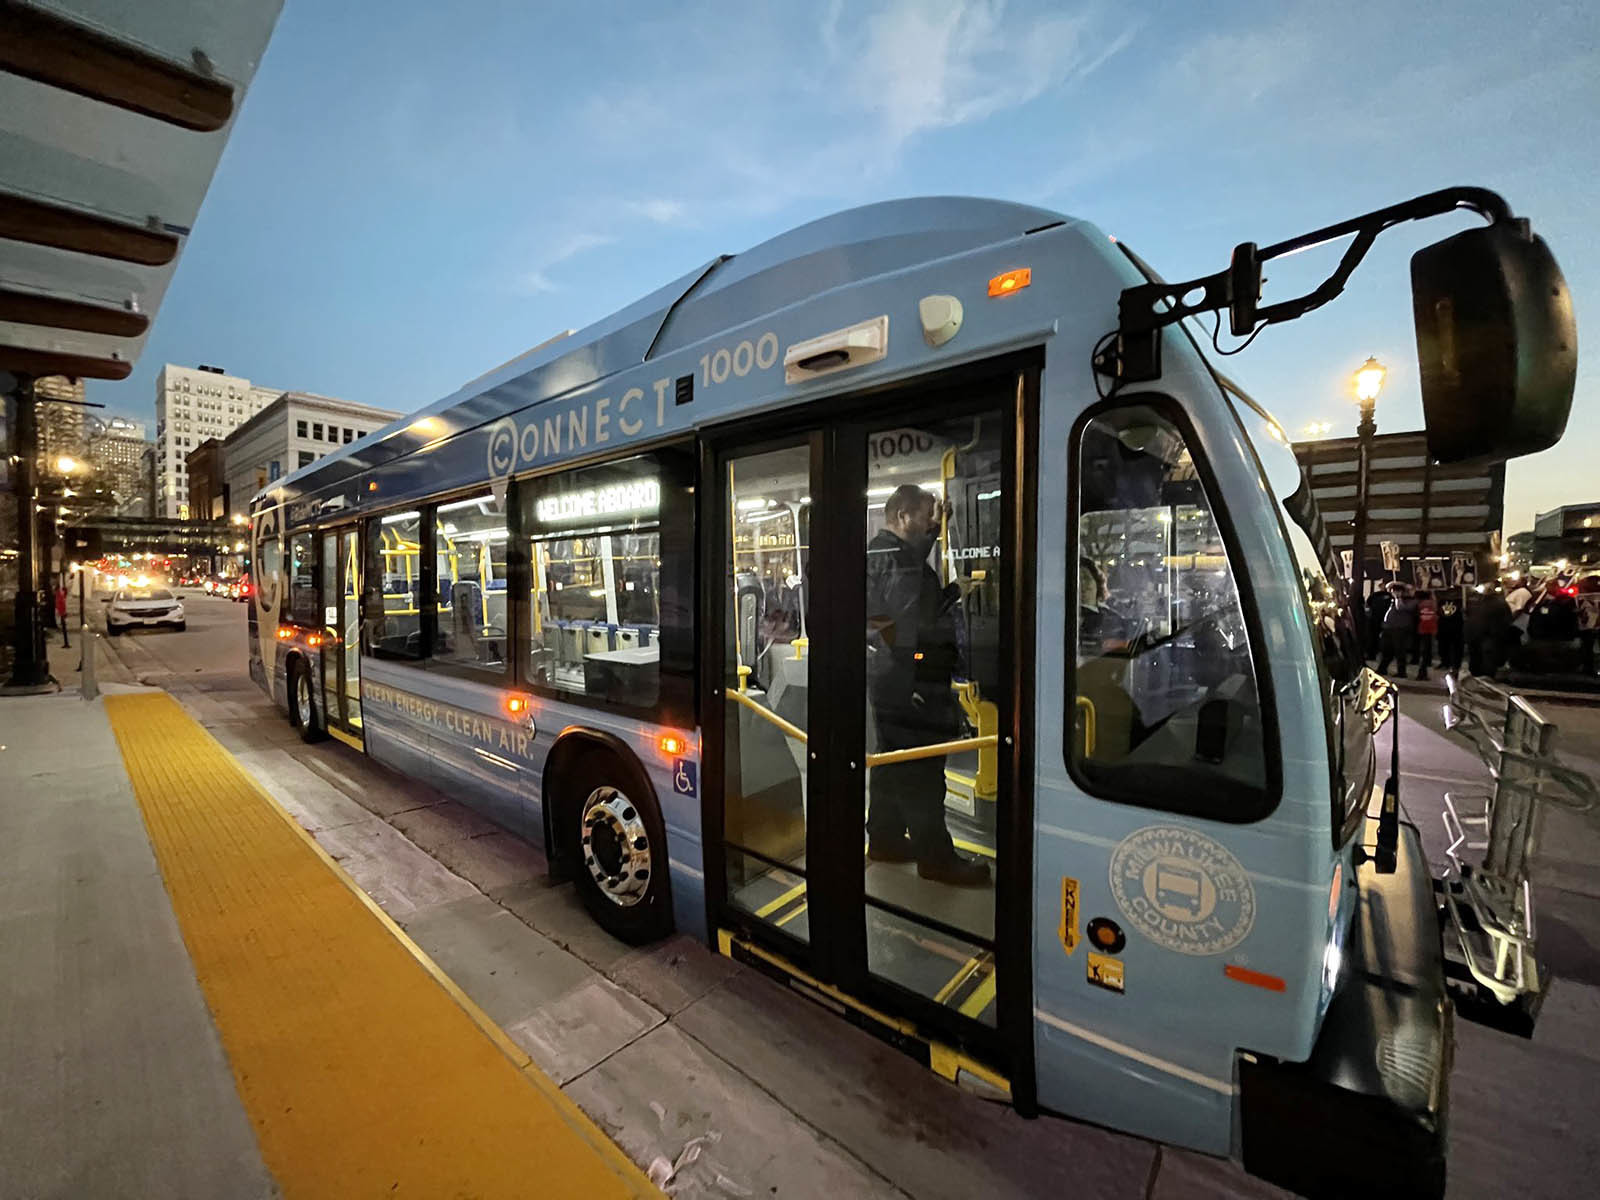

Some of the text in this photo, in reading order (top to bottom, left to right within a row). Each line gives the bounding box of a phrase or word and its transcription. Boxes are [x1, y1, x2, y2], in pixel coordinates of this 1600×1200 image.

[700, 332, 779, 388] 1000
[488, 378, 671, 473] CONNECT
[869, 433, 934, 460] 1000
[537, 480, 660, 521] WELCOME ABOARD
[445, 711, 493, 744] CLEAN
[499, 728, 534, 761] AIR.
[1125, 841, 1237, 902] MILWAUKEE
[1132, 896, 1225, 940] COUNTY
